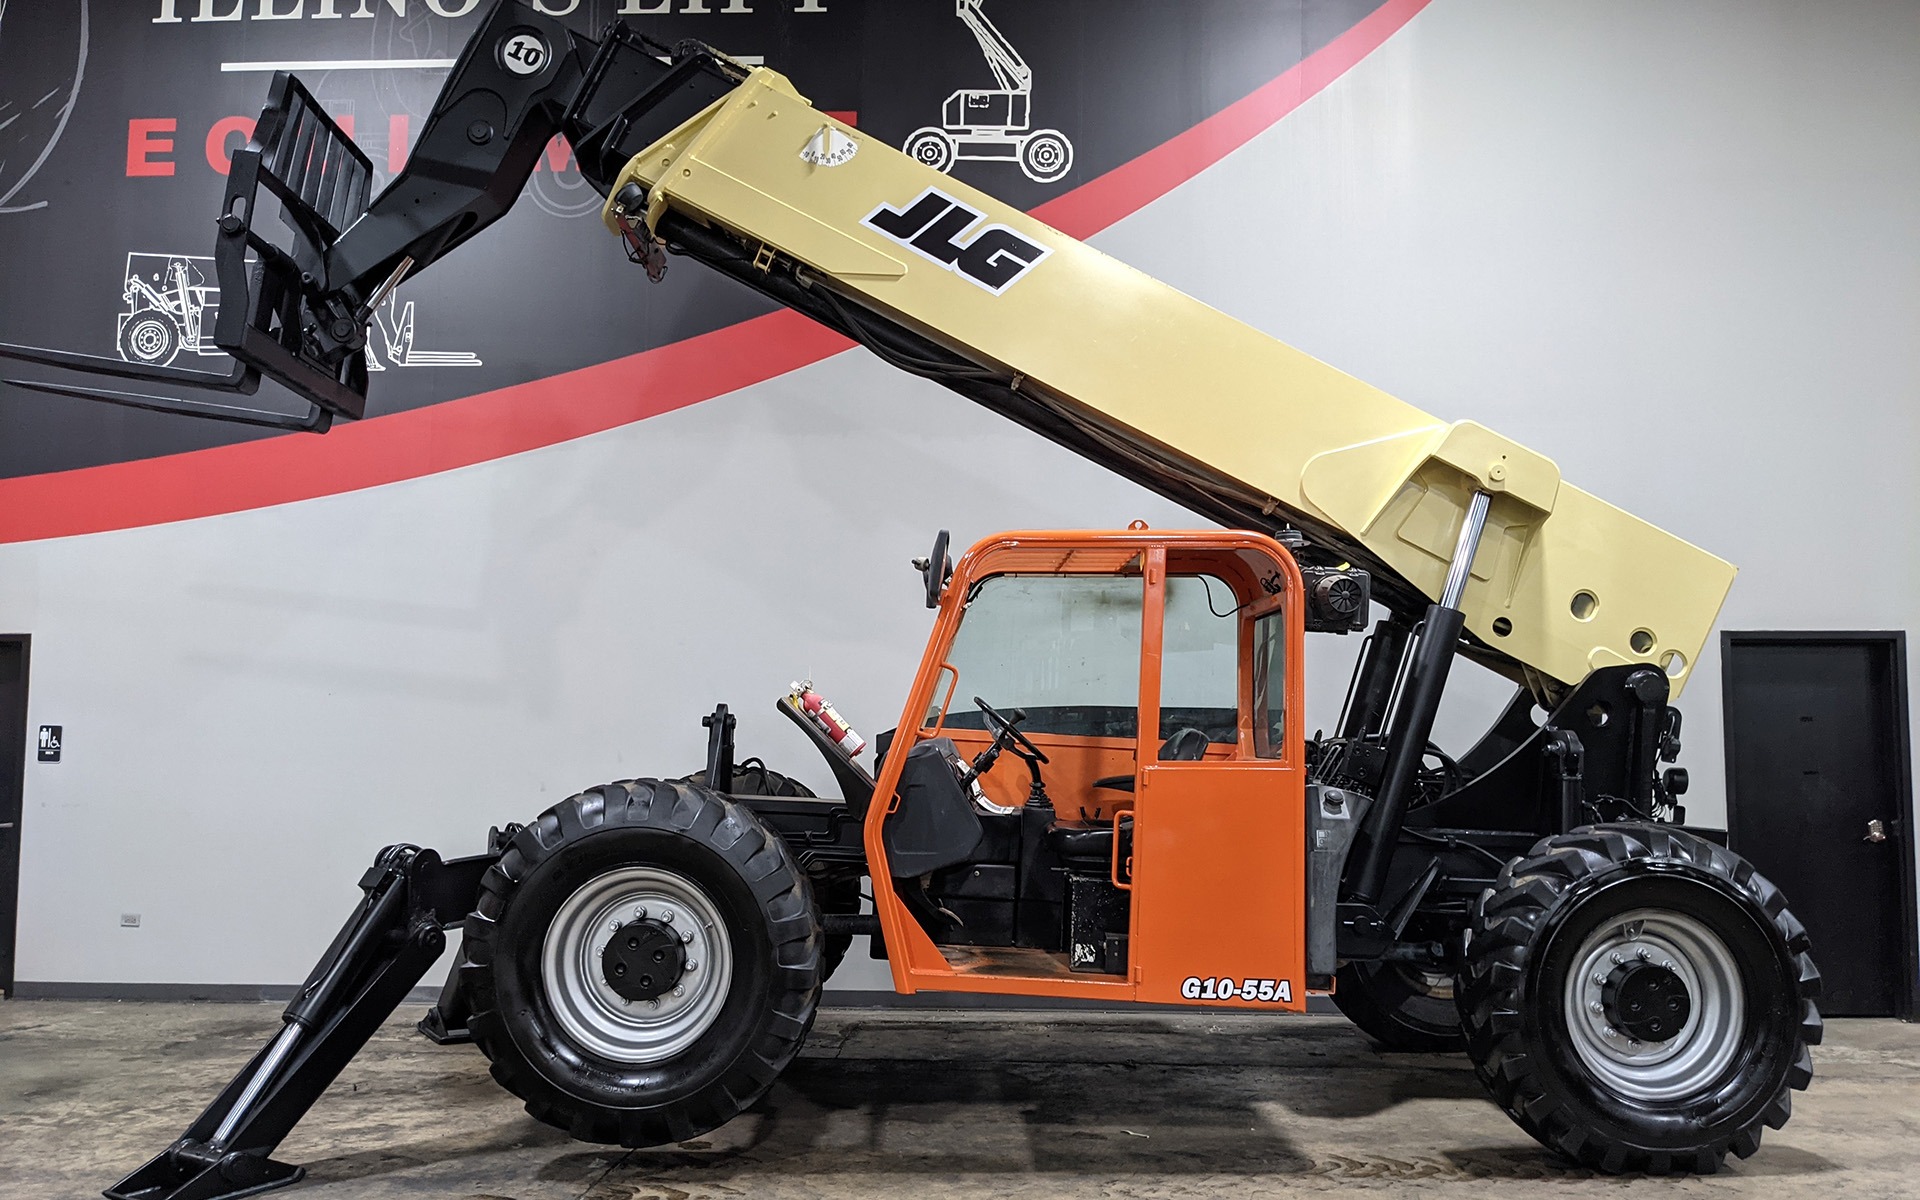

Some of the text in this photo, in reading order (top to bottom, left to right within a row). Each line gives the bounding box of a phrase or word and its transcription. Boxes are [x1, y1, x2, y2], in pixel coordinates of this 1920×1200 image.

[507, 41, 541, 67] 10
[867, 190, 1046, 291] JLG
[1182, 977, 1292, 1002] G10-55A
